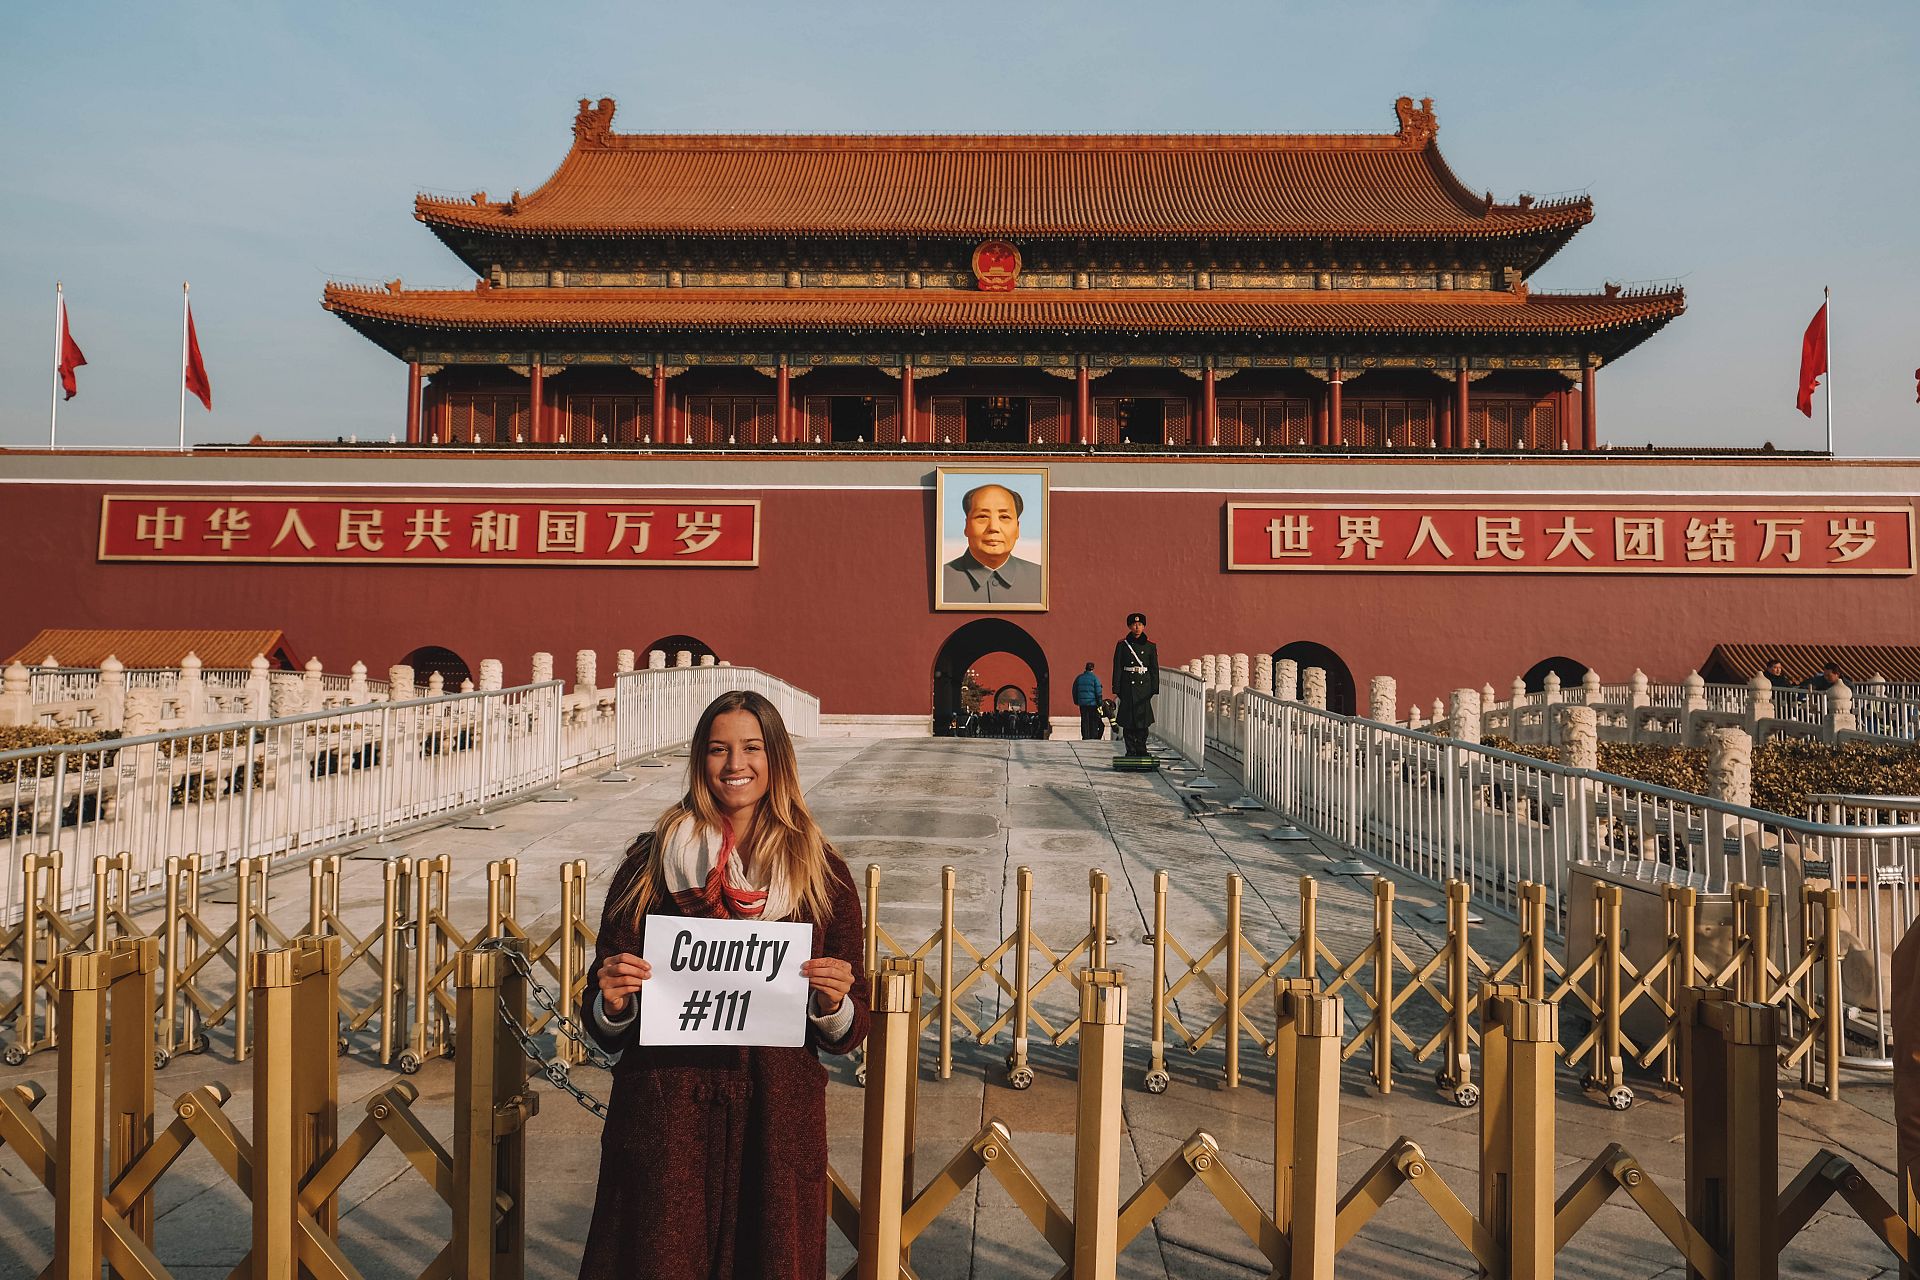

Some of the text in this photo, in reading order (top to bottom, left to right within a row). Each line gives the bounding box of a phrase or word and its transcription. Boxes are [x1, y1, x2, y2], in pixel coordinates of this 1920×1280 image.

[135, 507, 723, 554] 中华人民共和国万岁
[1265, 515, 1878, 563] 世界人民大团结万岁
[670, 930, 789, 982] Country
[678, 990, 751, 1031] #111
